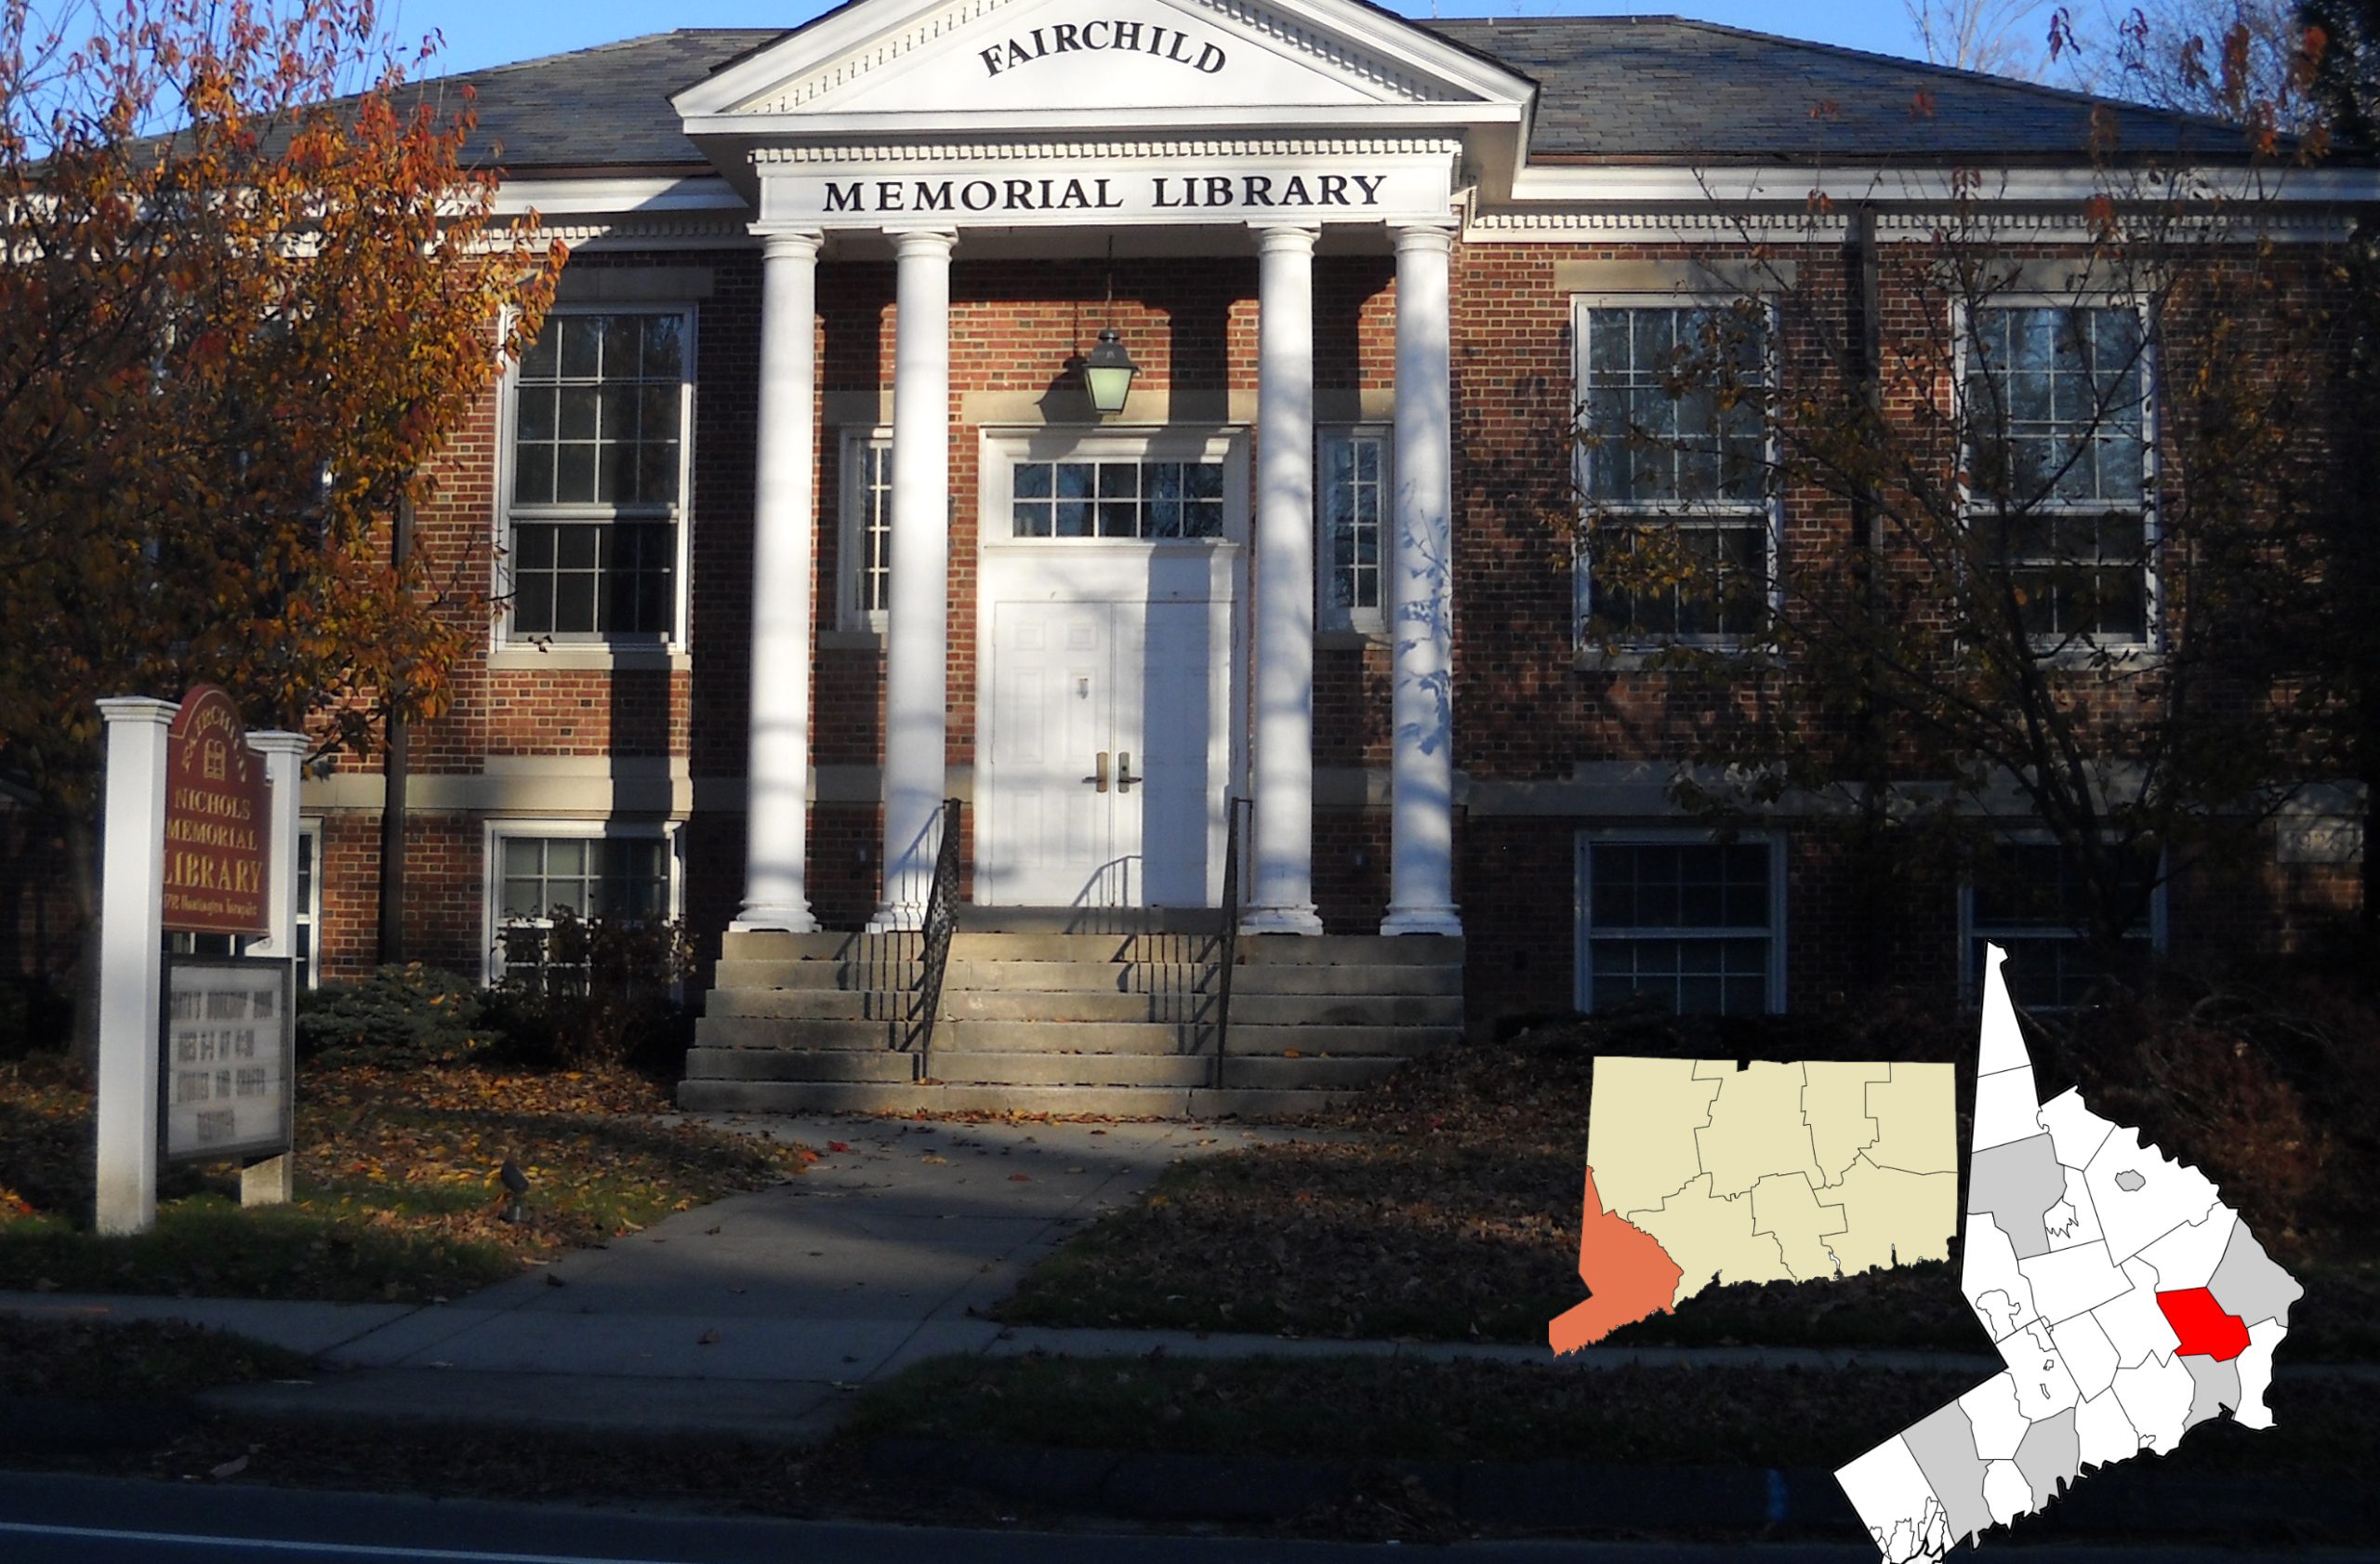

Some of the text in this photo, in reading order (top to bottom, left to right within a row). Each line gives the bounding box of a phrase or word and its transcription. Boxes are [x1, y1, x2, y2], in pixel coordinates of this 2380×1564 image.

[978, 20, 1227, 78] FAIRCHILD
[822, 175, 1387, 212] MEMORIAL LIBRARY
[175, 788, 251, 821] NICHOLS
[166, 817, 258, 852] MEMORIAL
[164, 849, 262, 894] LIBRARY
